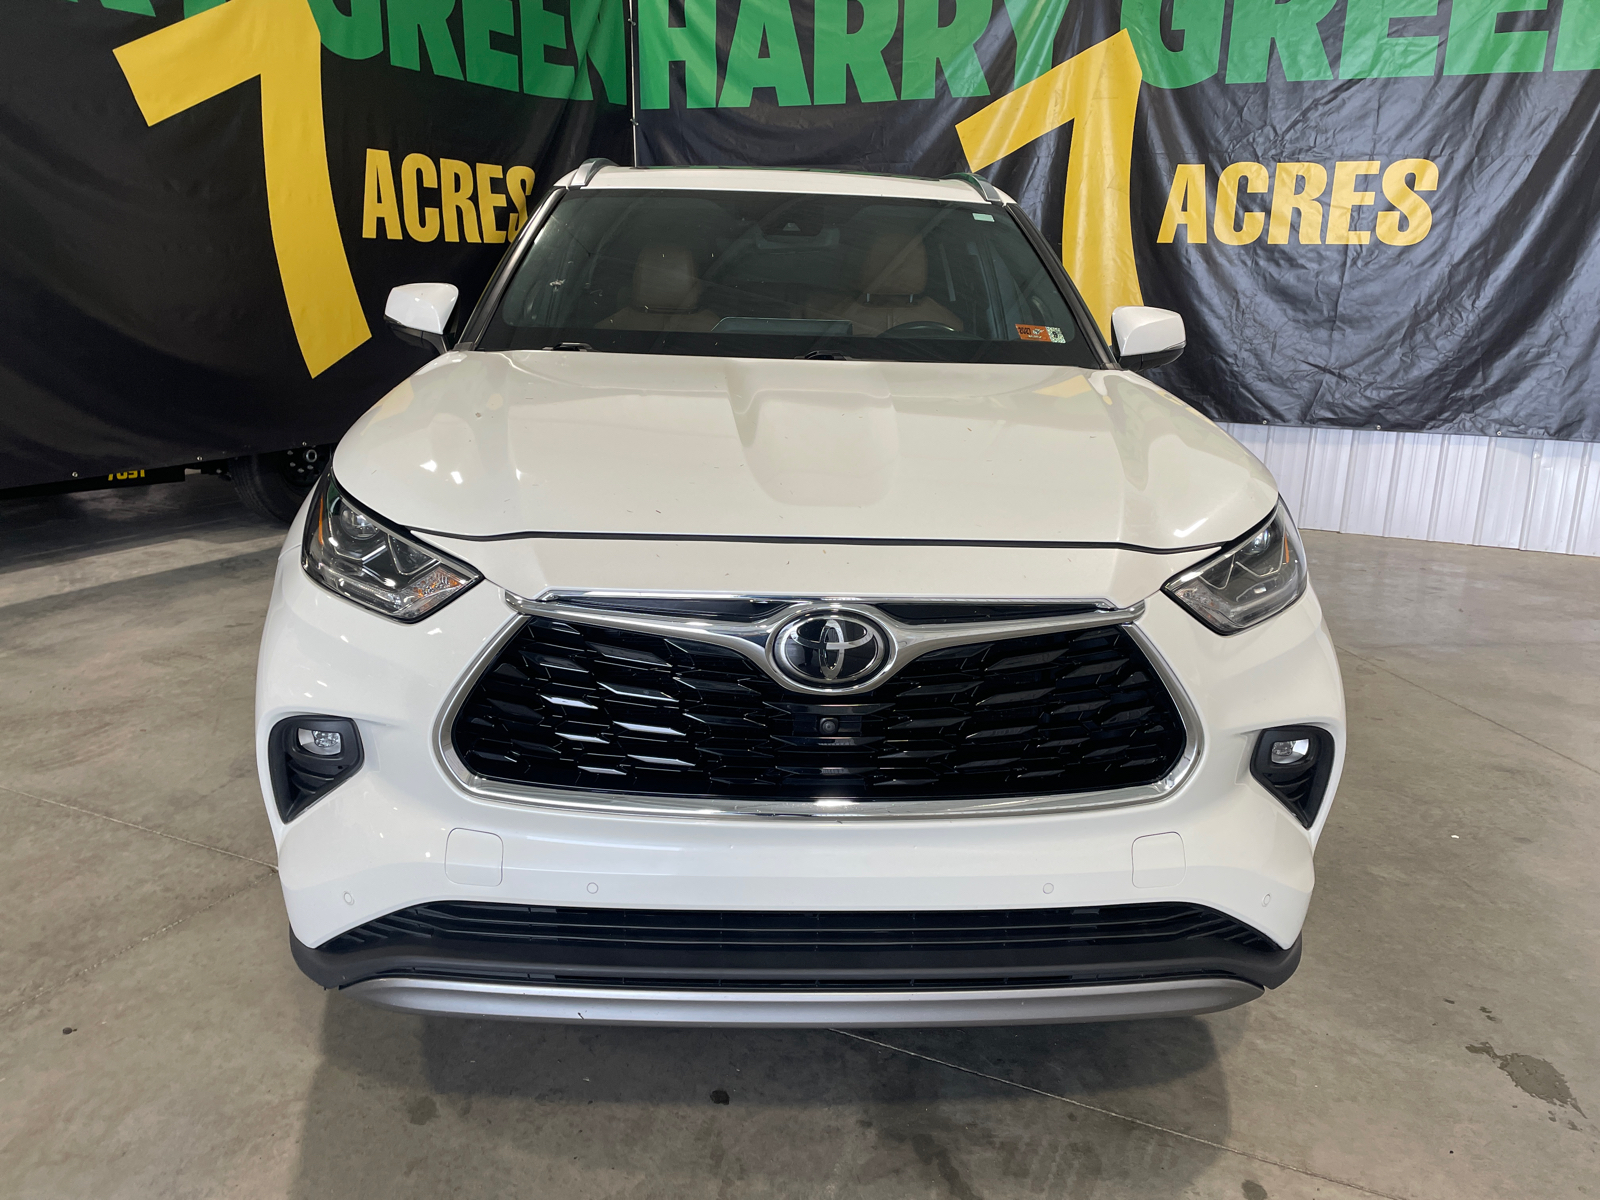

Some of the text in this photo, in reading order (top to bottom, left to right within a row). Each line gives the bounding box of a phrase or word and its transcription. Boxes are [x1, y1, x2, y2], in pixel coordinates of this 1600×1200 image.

[113, 0, 535, 379] 7 ACRES
[640, 0, 1068, 110] HARRY
[957, 28, 1440, 347] 7 ACRES
